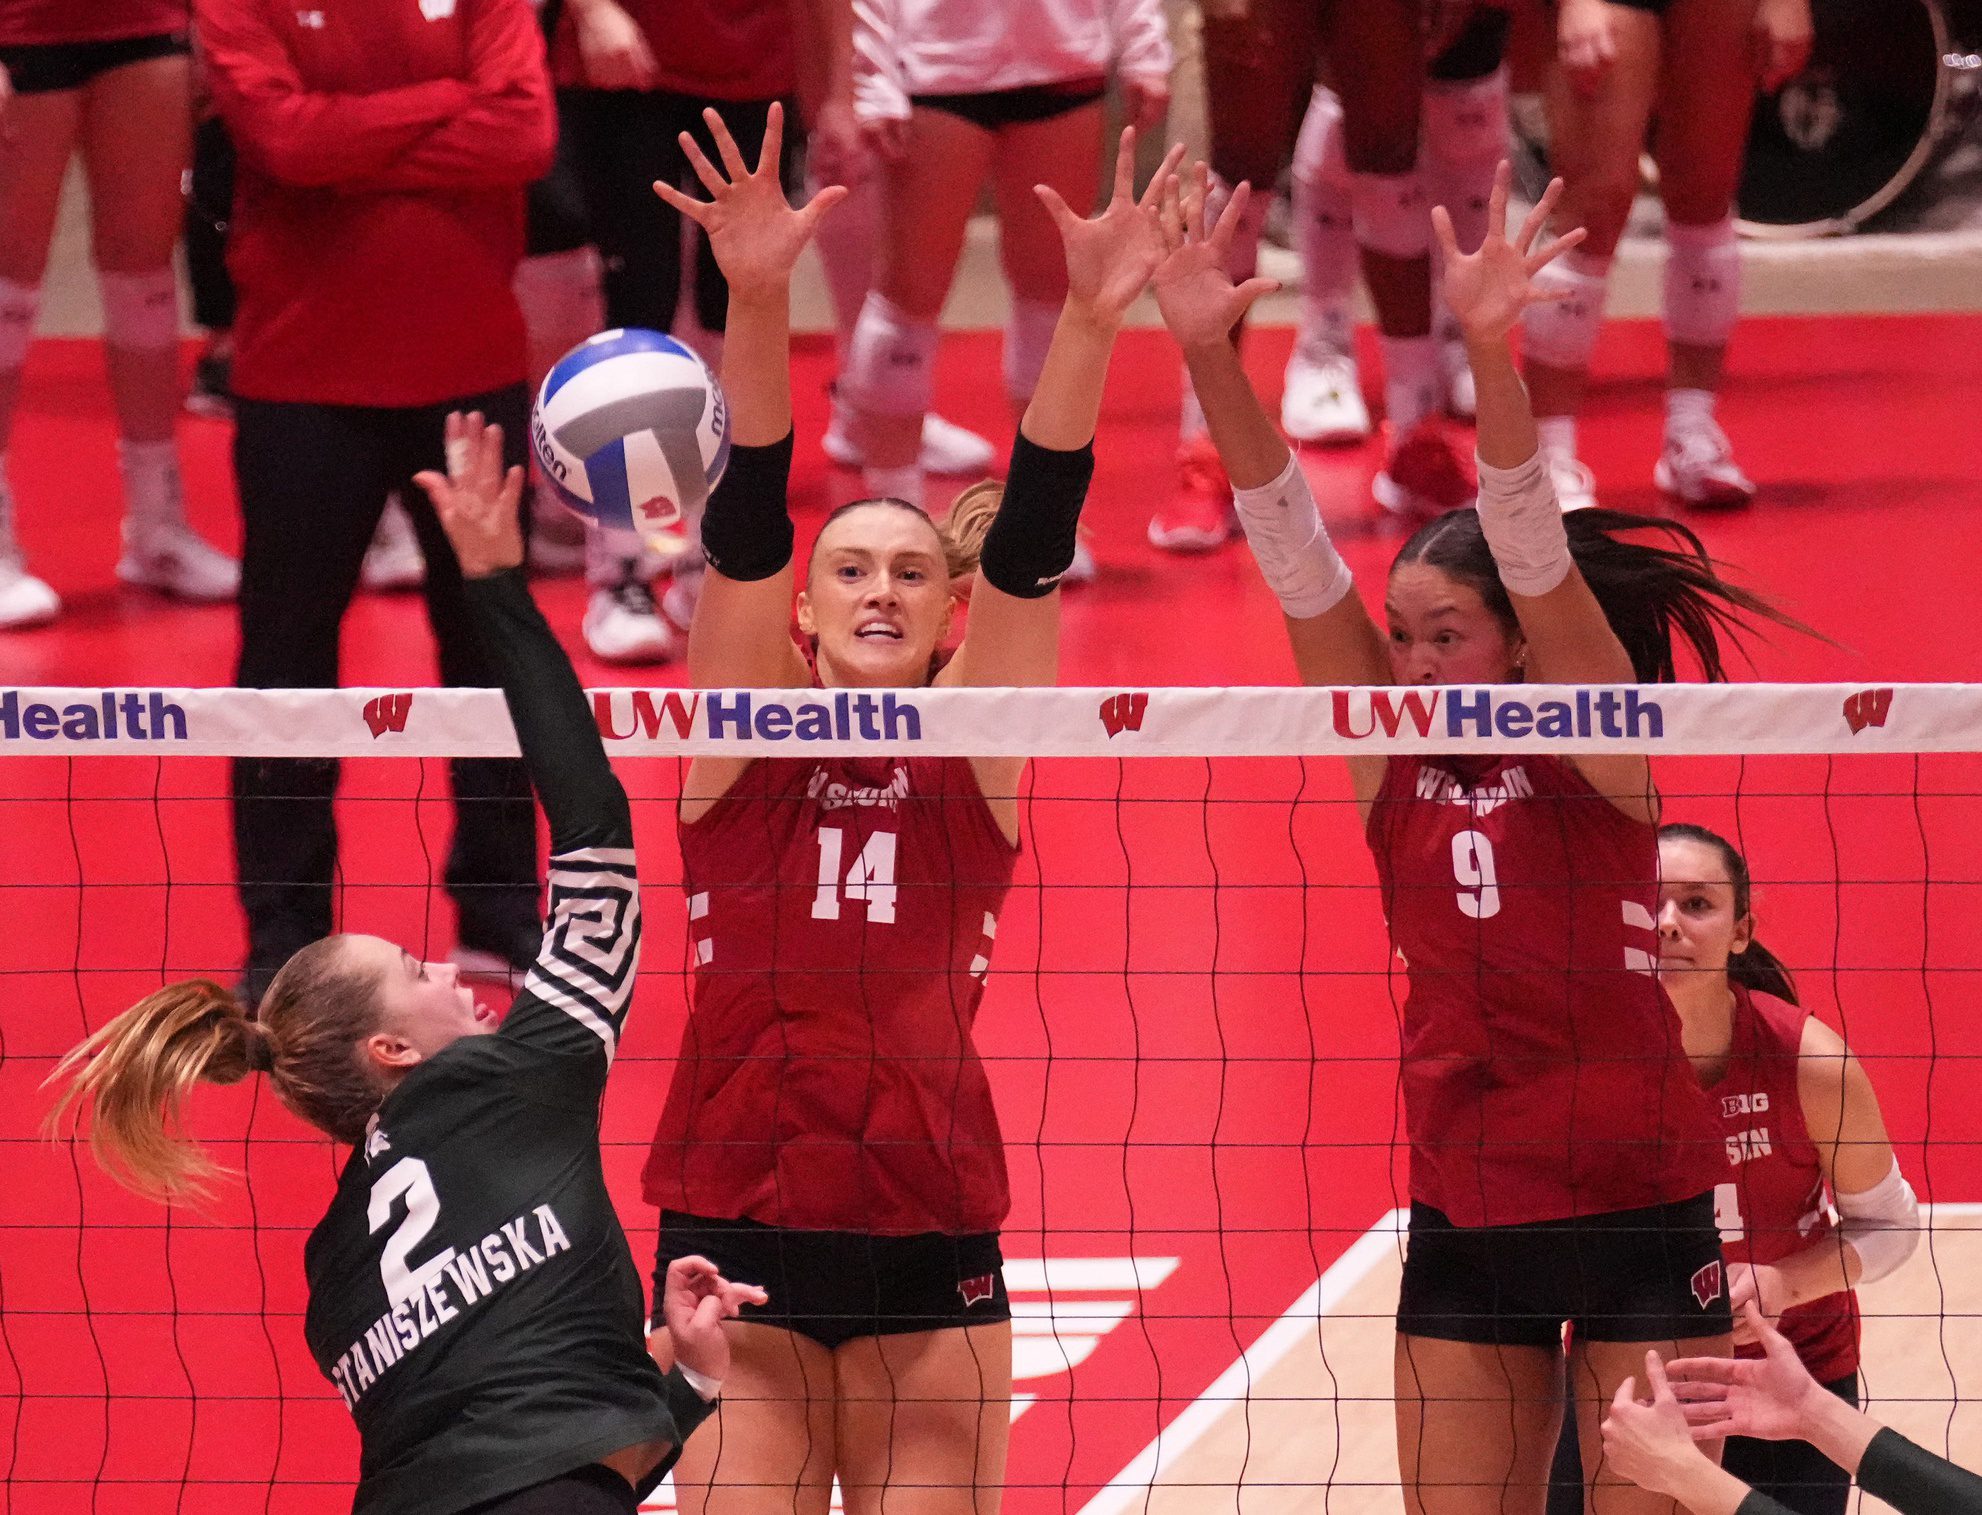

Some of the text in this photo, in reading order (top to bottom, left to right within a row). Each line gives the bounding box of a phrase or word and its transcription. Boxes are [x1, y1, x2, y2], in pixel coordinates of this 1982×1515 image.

[811, 827, 897, 923] 14
[1452, 830, 1500, 919] 9
[367, 1156, 456, 1310] 2
